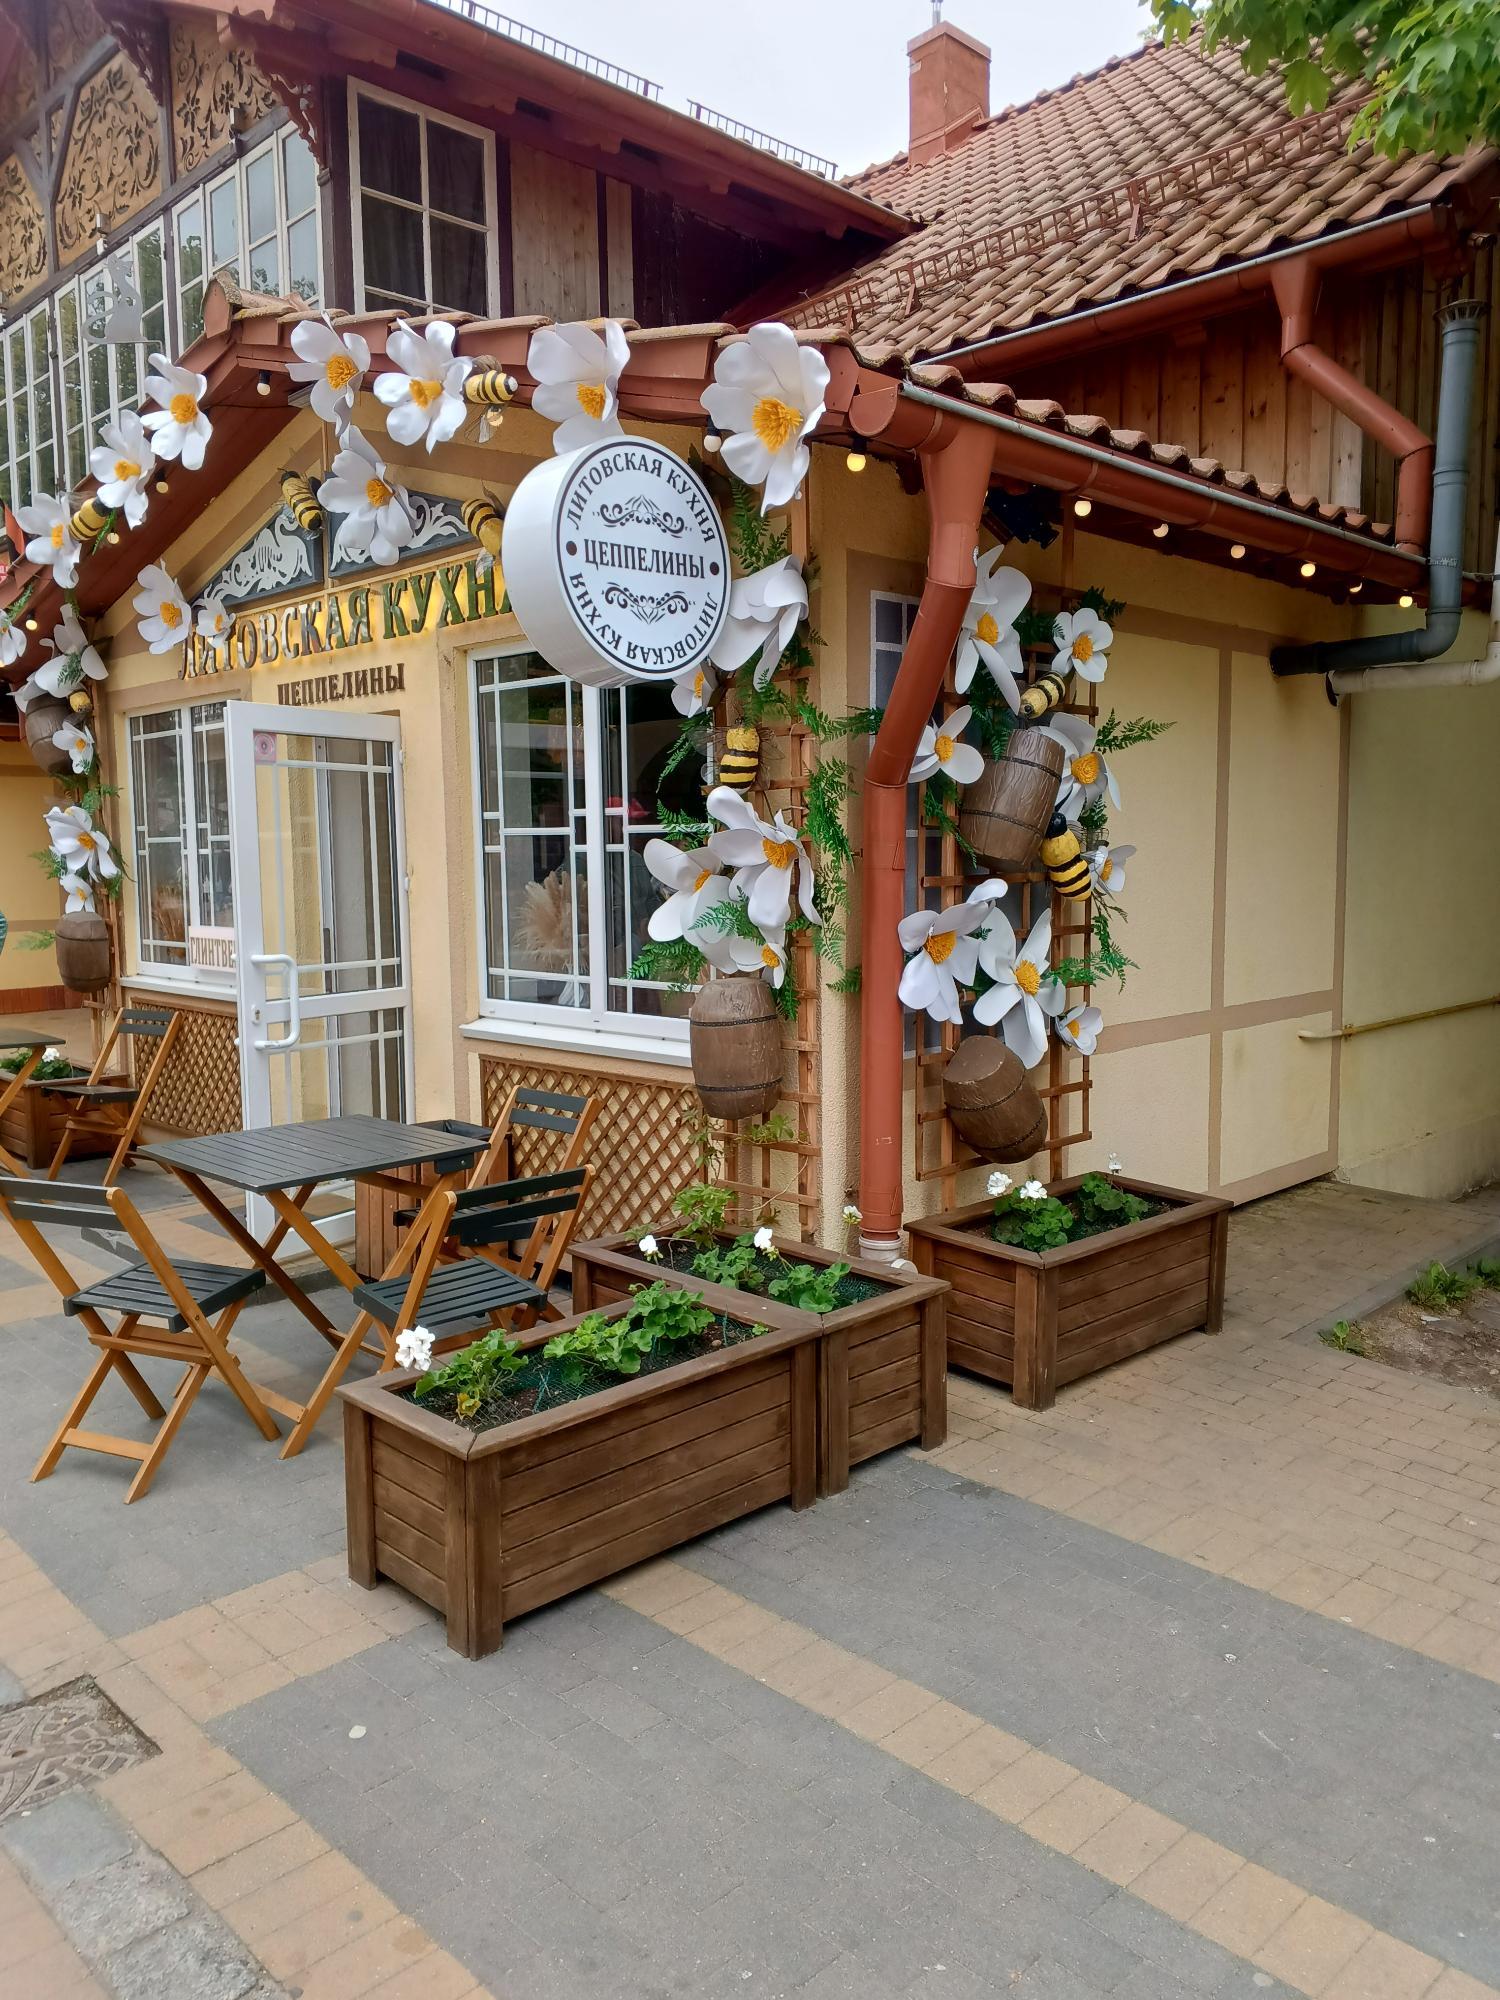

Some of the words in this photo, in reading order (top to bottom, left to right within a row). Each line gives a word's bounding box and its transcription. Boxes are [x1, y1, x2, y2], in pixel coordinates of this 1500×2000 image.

[567, 452, 663, 530] ЛИТОВСКАЯ
[666, 468, 716, 544] КУХНЯ
[584, 538, 706, 579] ЦЕППЕЛИНЫ
[382, 560, 513, 640] КУХН
[569, 572, 622, 651] КУХНЯ
[627, 592, 719, 665] ЛИТОВСКАЯ
[277, 662, 406, 706] ЦЕППЕЛИНЫ
[190, 937, 237, 968] ГЛИНТВЕ
